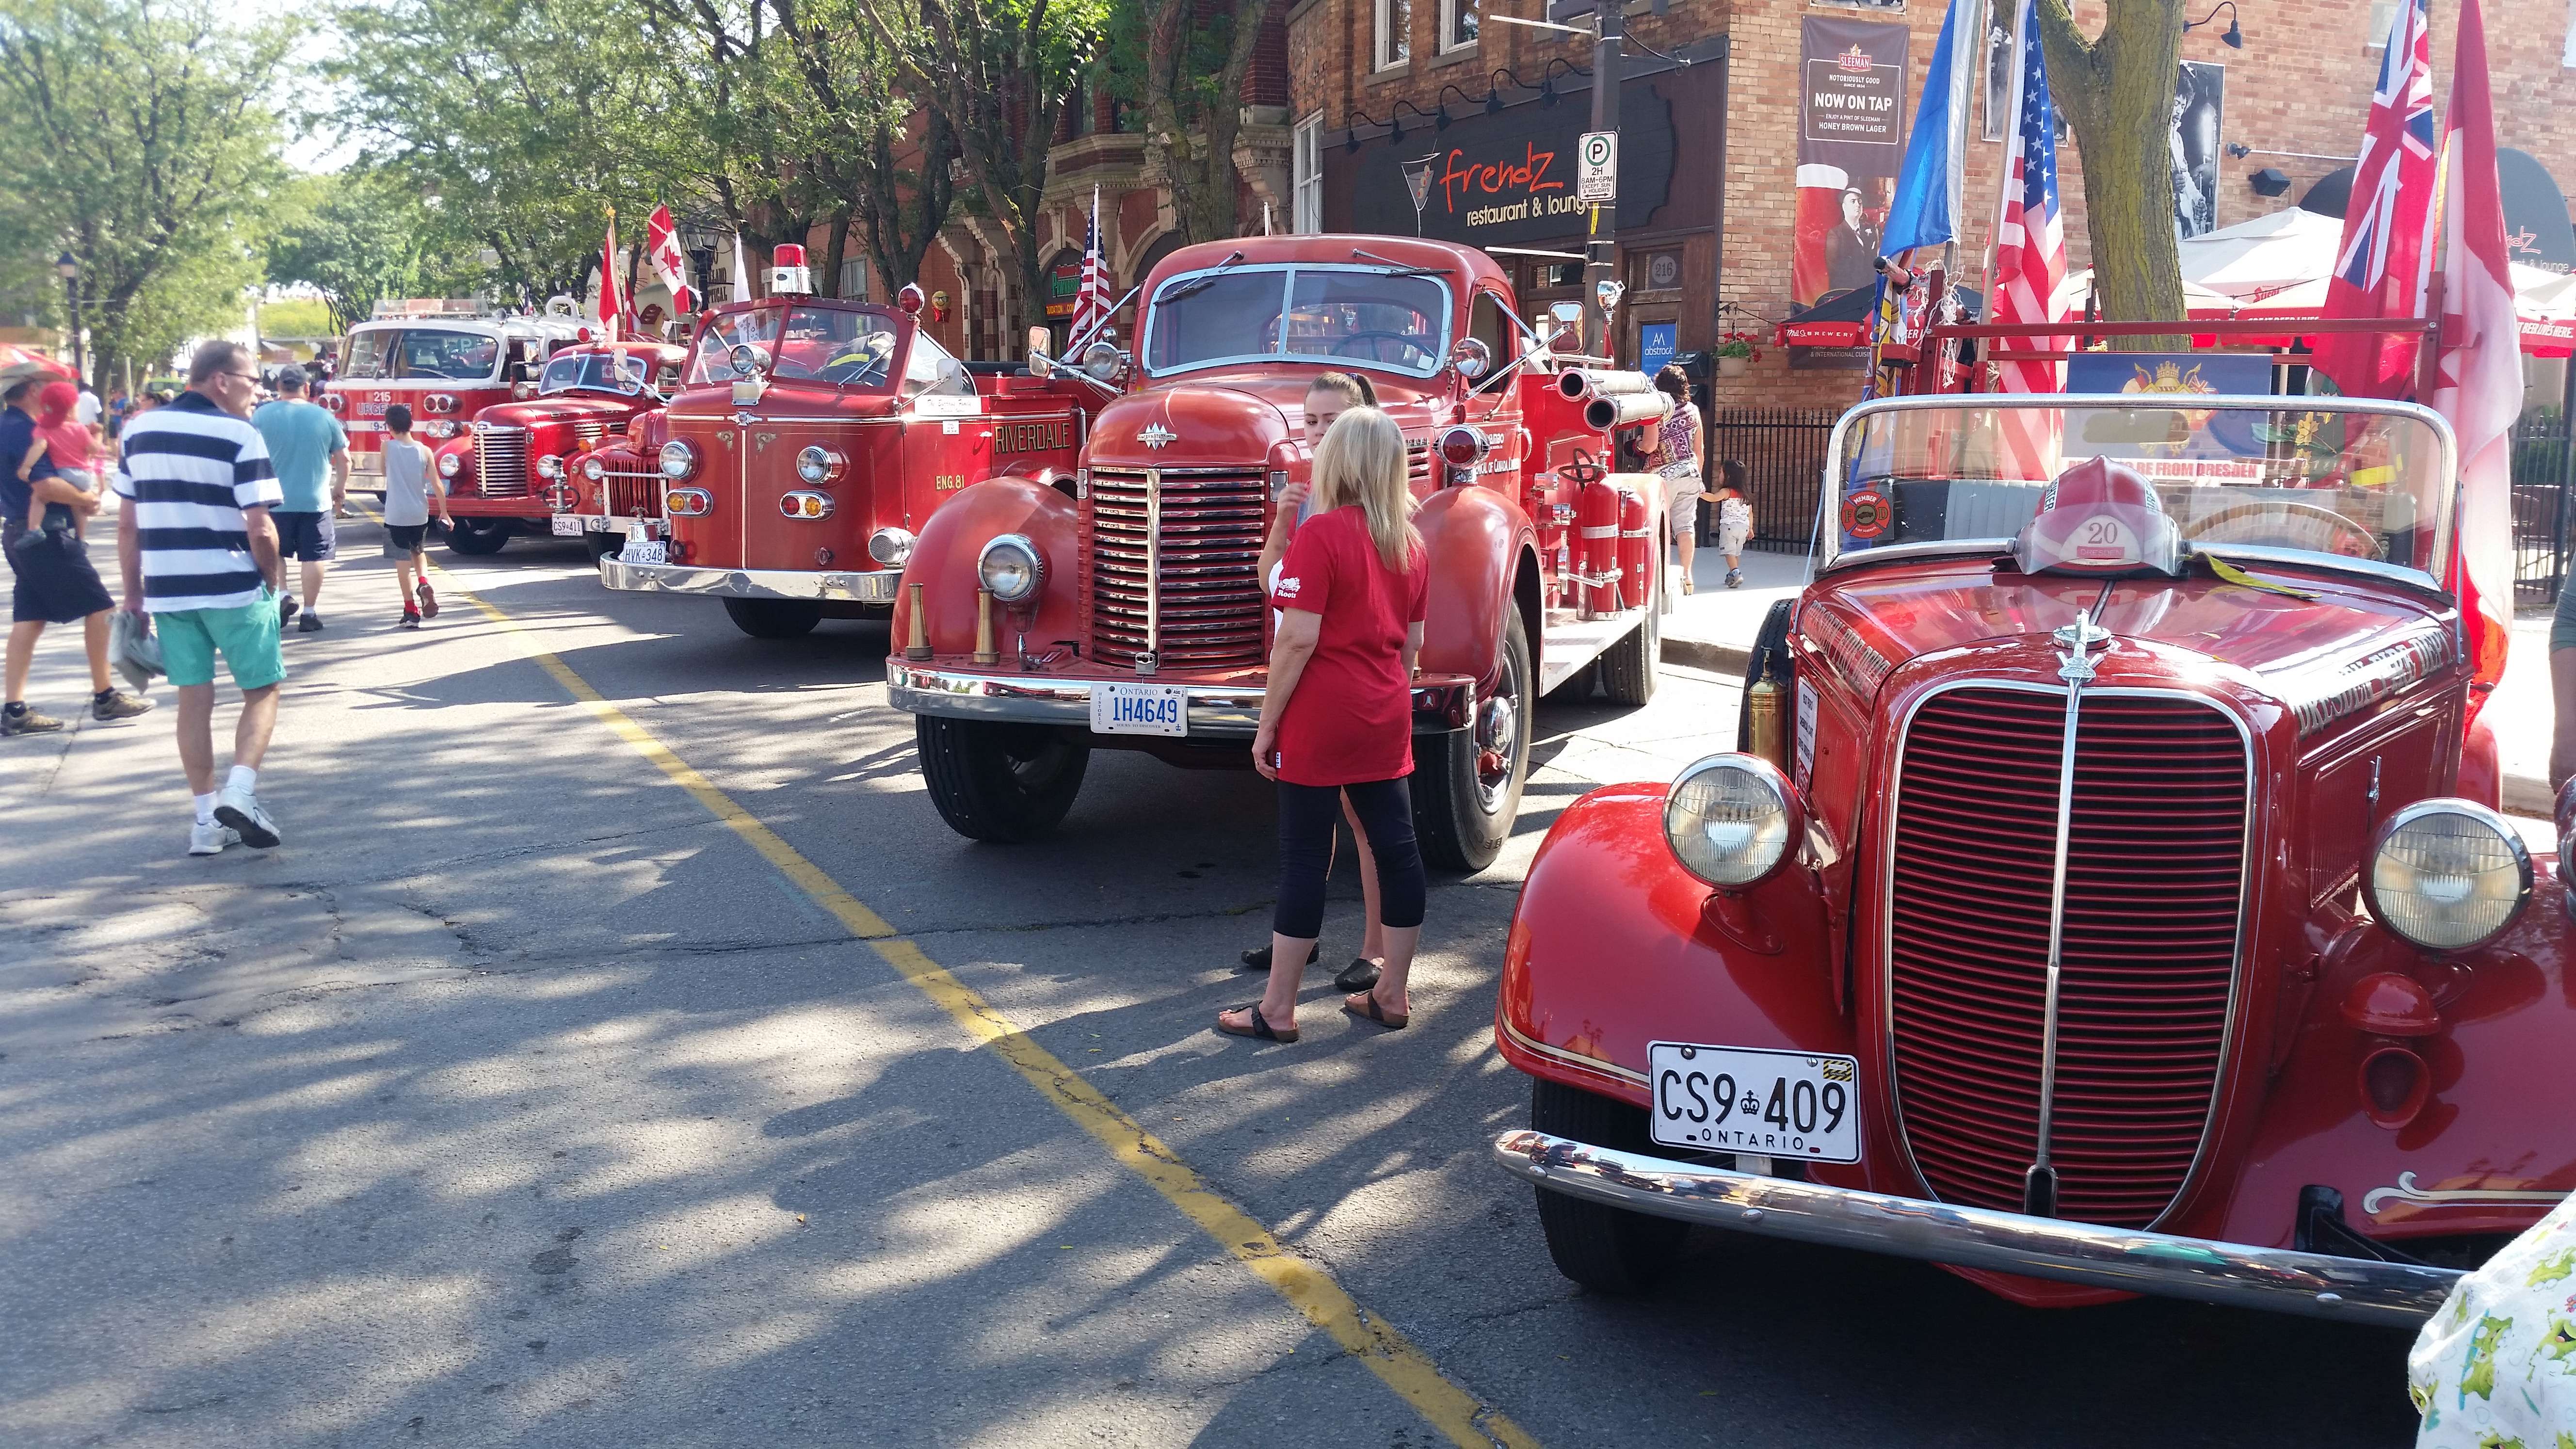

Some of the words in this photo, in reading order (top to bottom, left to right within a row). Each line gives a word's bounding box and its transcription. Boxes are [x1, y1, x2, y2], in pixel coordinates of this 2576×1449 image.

[1841, 57, 1869, 68] SLEEMAN
[1829, 74, 1865, 83] NOTORIOUSLY
[1815, 93, 1845, 108] NOW
[1848, 95, 1866, 110] ON
[1868, 97, 1893, 111] TAP
[1819, 122, 1840, 130] HONEY
[1841, 123, 1865, 131] BROWN
[1866, 125, 1886, 133] LAGER
[1593, 144, 1603, 159] P
[1439, 142, 1564, 213] frendz
[1592, 167, 1603, 175] 2H
[1581, 176, 1612, 184] 8AM-6PM
[1467, 198, 1528, 227] restaurant
[1532, 196, 1542, 217] &
[1548, 194, 1589, 215] loung
[1655, 262, 1673, 276] 216
[2540, 259, 2569, 274] lounge
[1051, 272, 1080, 298] PAWNBRO
[2522, 322, 2539, 335] BEER
[2553, 325, 2574, 338] HERE.
[1644, 346, 1673, 355] abstract
[374, 391, 391, 402] 215
[357, 402, 412, 415] URGEE
[995, 422, 1071, 453] RIVERDALE
[1488, 462, 1494, 473] OF
[2156, 463, 2193, 476] FROM
[2197, 463, 2257, 478] DRESDEN
[936, 476, 954, 490] ENG.
[955, 475, 965, 488] 81
[1853, 495, 1877, 504] MEMBER
[1844, 509, 1852, 523] F
[1878, 507, 1888, 520] D
[554, 521, 566, 531] CS9
[569, 521, 581, 531] 411
[2088, 522, 2118, 544] 20
[626, 548, 641, 562] HVK
[646, 548, 662, 562] 348
[1277, 590, 1296, 598] Roots
[1113, 697, 1177, 723] 1H4649
[1660, 1069, 1736, 1125] CS9
[1764, 1077, 1846, 1134] 409
[1702, 1128, 1803, 1150] ONTARIO
